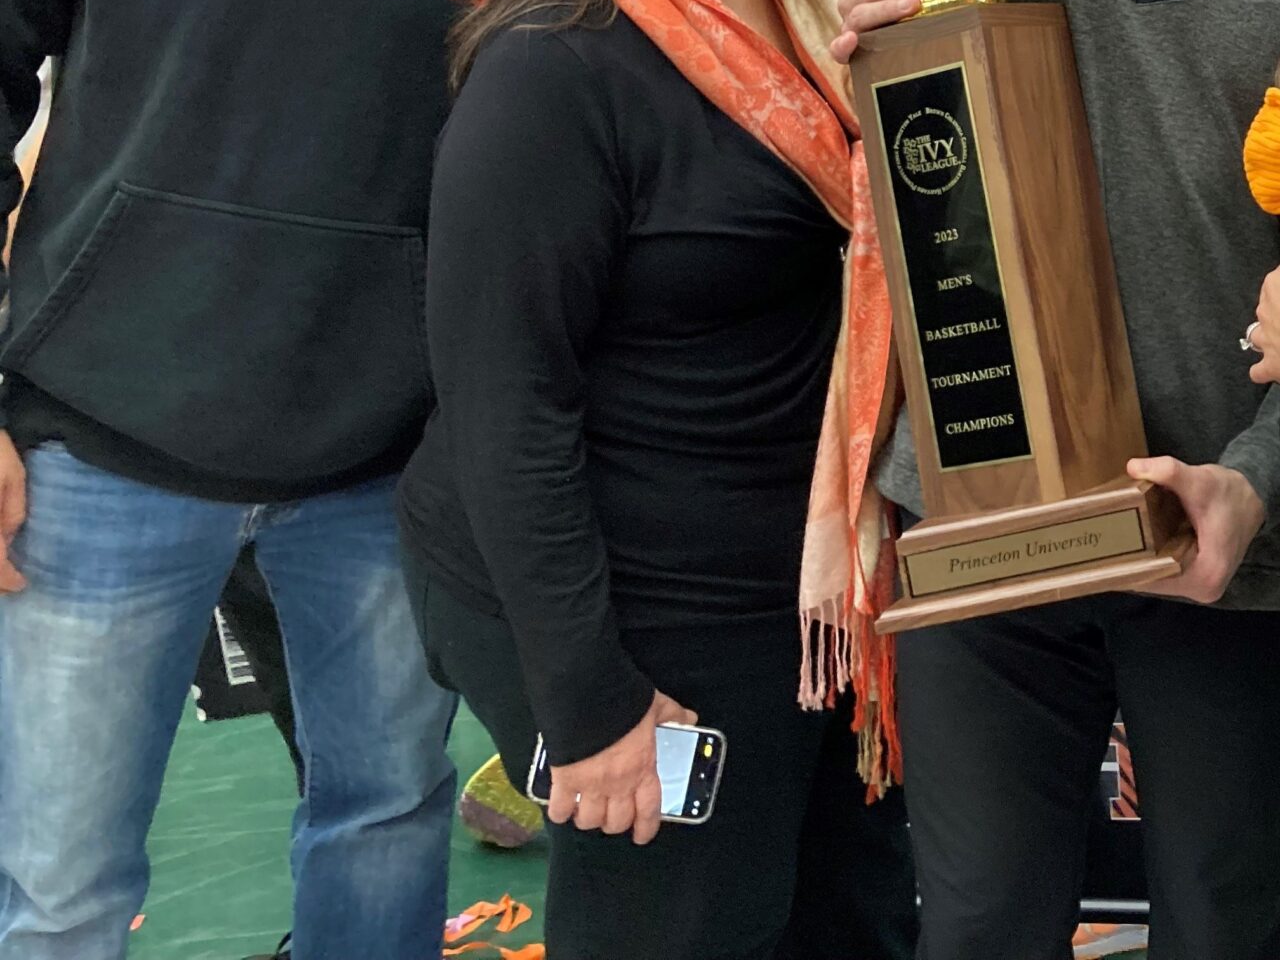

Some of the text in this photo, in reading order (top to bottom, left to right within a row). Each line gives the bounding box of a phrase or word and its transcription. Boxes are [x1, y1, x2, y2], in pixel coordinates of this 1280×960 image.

[915, 134, 931, 144] THE
[917, 136, 954, 163] IVY
[934, 228, 959, 244] 2023
[937, 274, 973, 291] MEN'S
[925, 318, 1001, 342] BASKETBALL
[930, 364, 1011, 389] TOURNAMENT
[945, 413, 1015, 435] CHAMPIONS
[949, 531, 1102, 573] Princeton University
